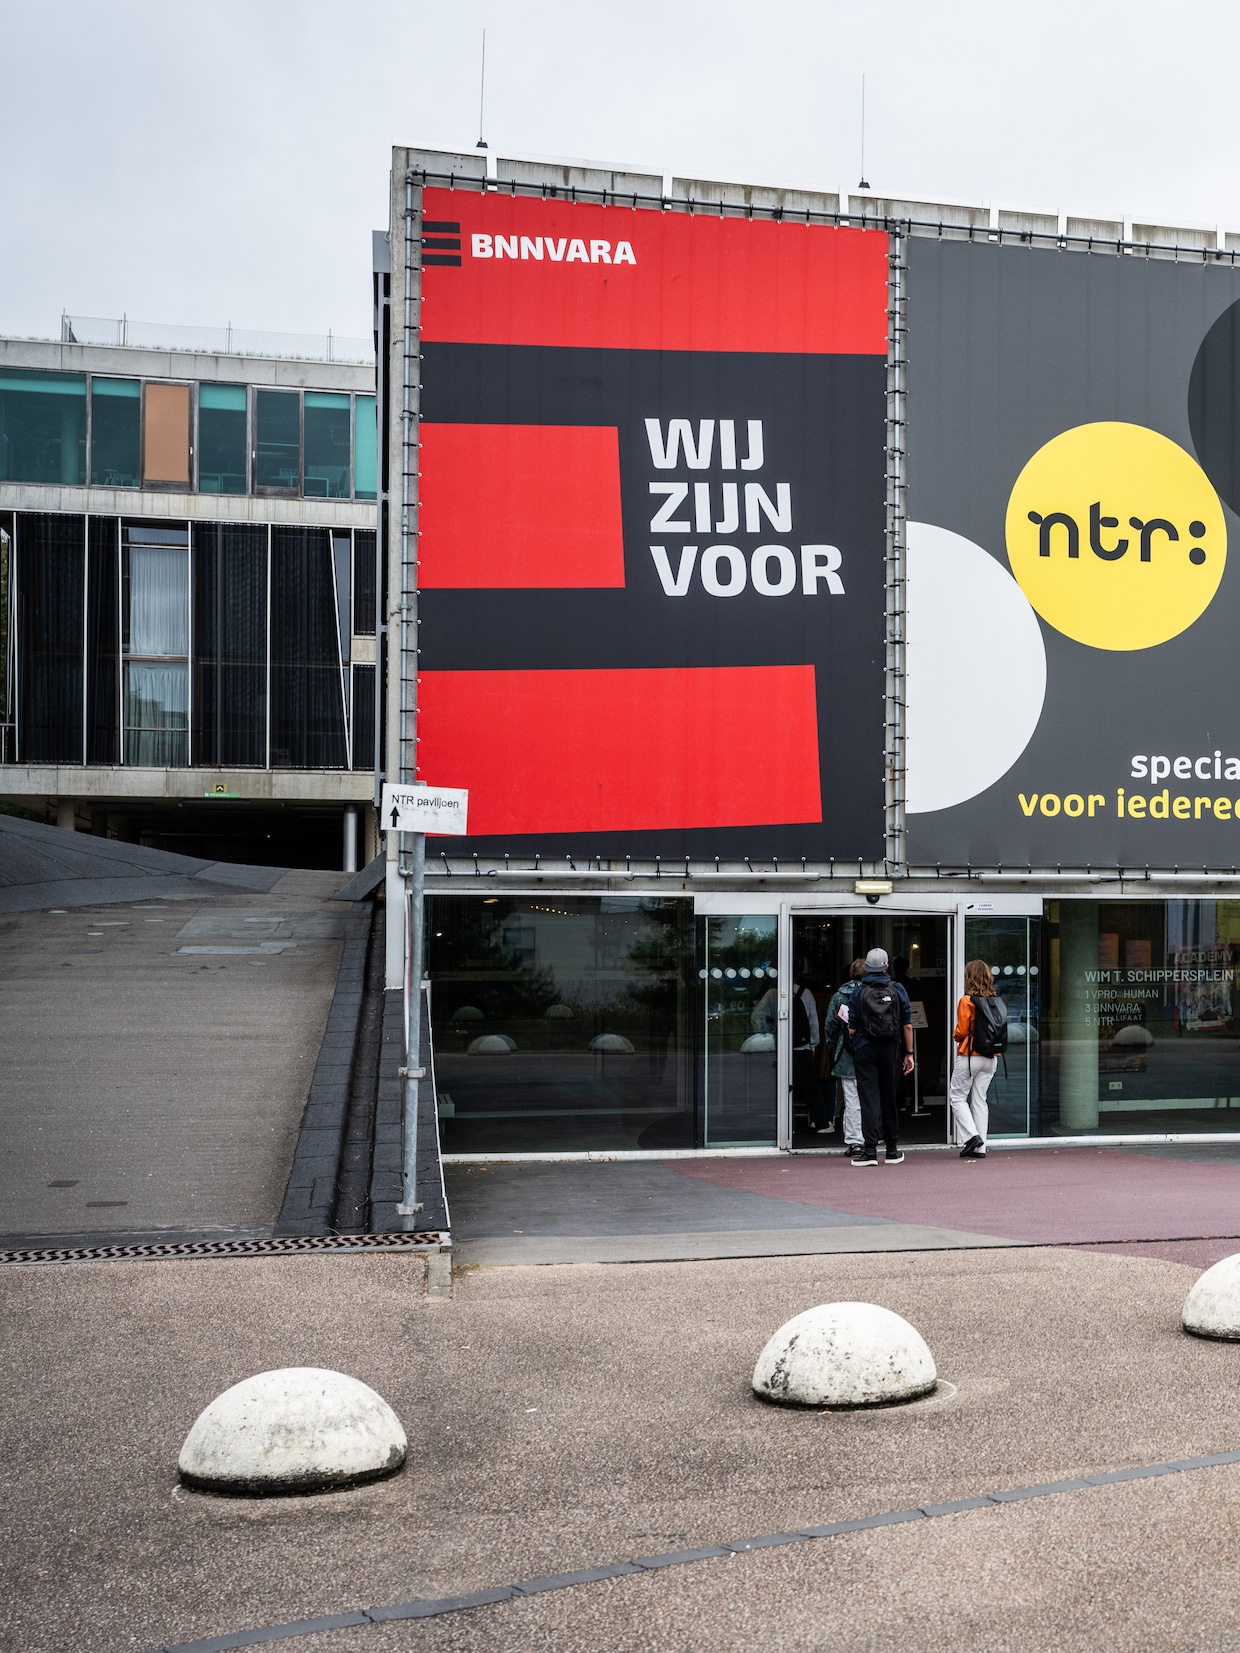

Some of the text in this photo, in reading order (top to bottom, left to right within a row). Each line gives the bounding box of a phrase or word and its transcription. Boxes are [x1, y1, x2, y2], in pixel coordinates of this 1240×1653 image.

[471, 233, 637, 265] BNNVARA
[644, 418, 764, 470] WIJ
[648, 482, 793, 534] ZIJN
[1027, 501, 1207, 566] ntr:
[649, 544, 846, 597] VOOR
[391, 794, 459, 809] NTR paviljoen
[1018, 793, 1105, 817] voor
[1174, 951, 1234, 964] ACADEMY
[1085, 970, 1234, 983] WIM T. SCHIPPERSPLEIN
[1085, 989, 1159, 999] 1 VPRO HUMAN
[1085, 1003, 1140, 1013] 3 BNNVARA
[1085, 1016, 1114, 1026] 5 NTR
